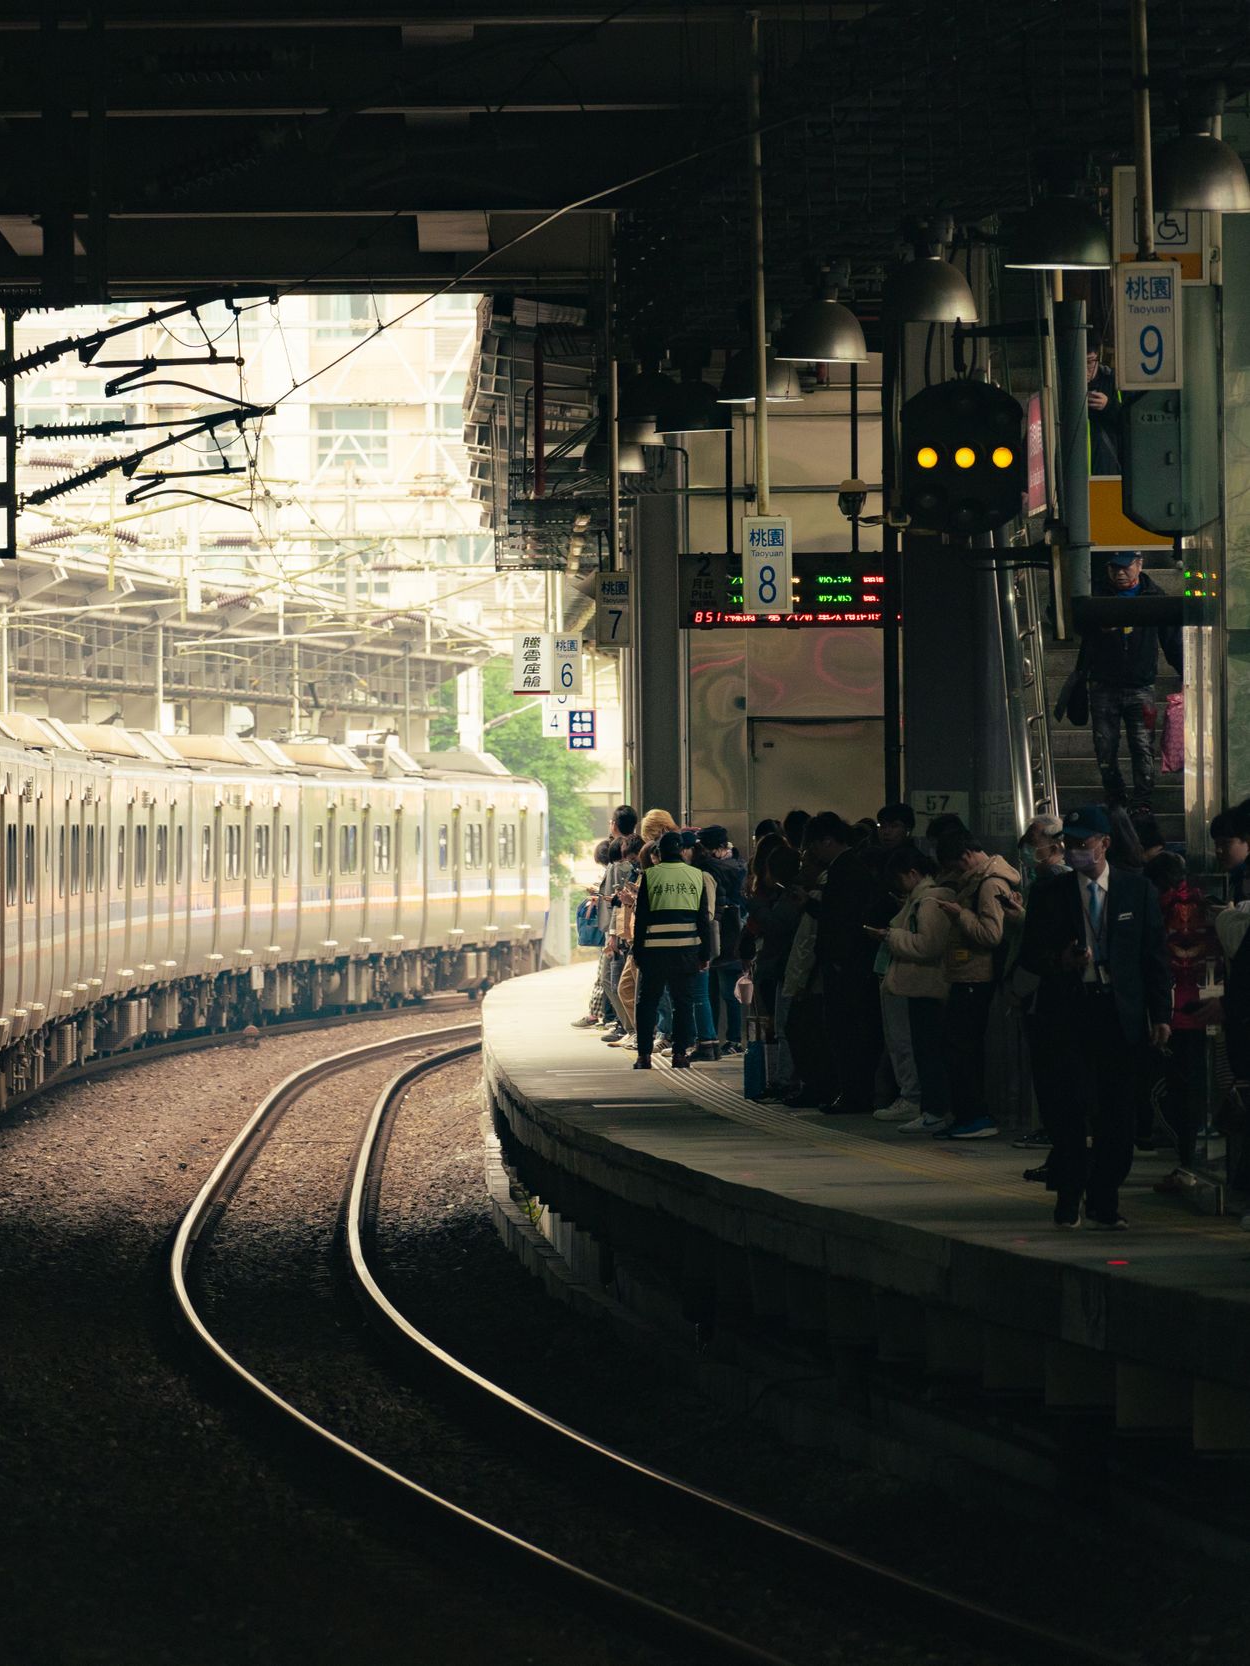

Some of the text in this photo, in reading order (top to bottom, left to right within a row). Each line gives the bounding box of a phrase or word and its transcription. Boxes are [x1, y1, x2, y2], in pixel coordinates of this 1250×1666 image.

[1126, 276, 1171, 300] 桃園
[1128, 304, 1171, 315] Taoyuan
[1140, 325, 1163, 375] 9
[750, 528, 784, 547] 桃園
[751, 550, 784, 558] Taoyuan
[696, 556, 711, 577] 2
[601, 581, 629, 595] 桃園
[692, 578, 714, 589] 月台
[758, 565, 777, 603] 8
[609, 610, 622, 639] 7
[556, 640, 579, 652] 桃園
[561, 663, 573, 688] 6
[926, 795, 950, 811] 57
